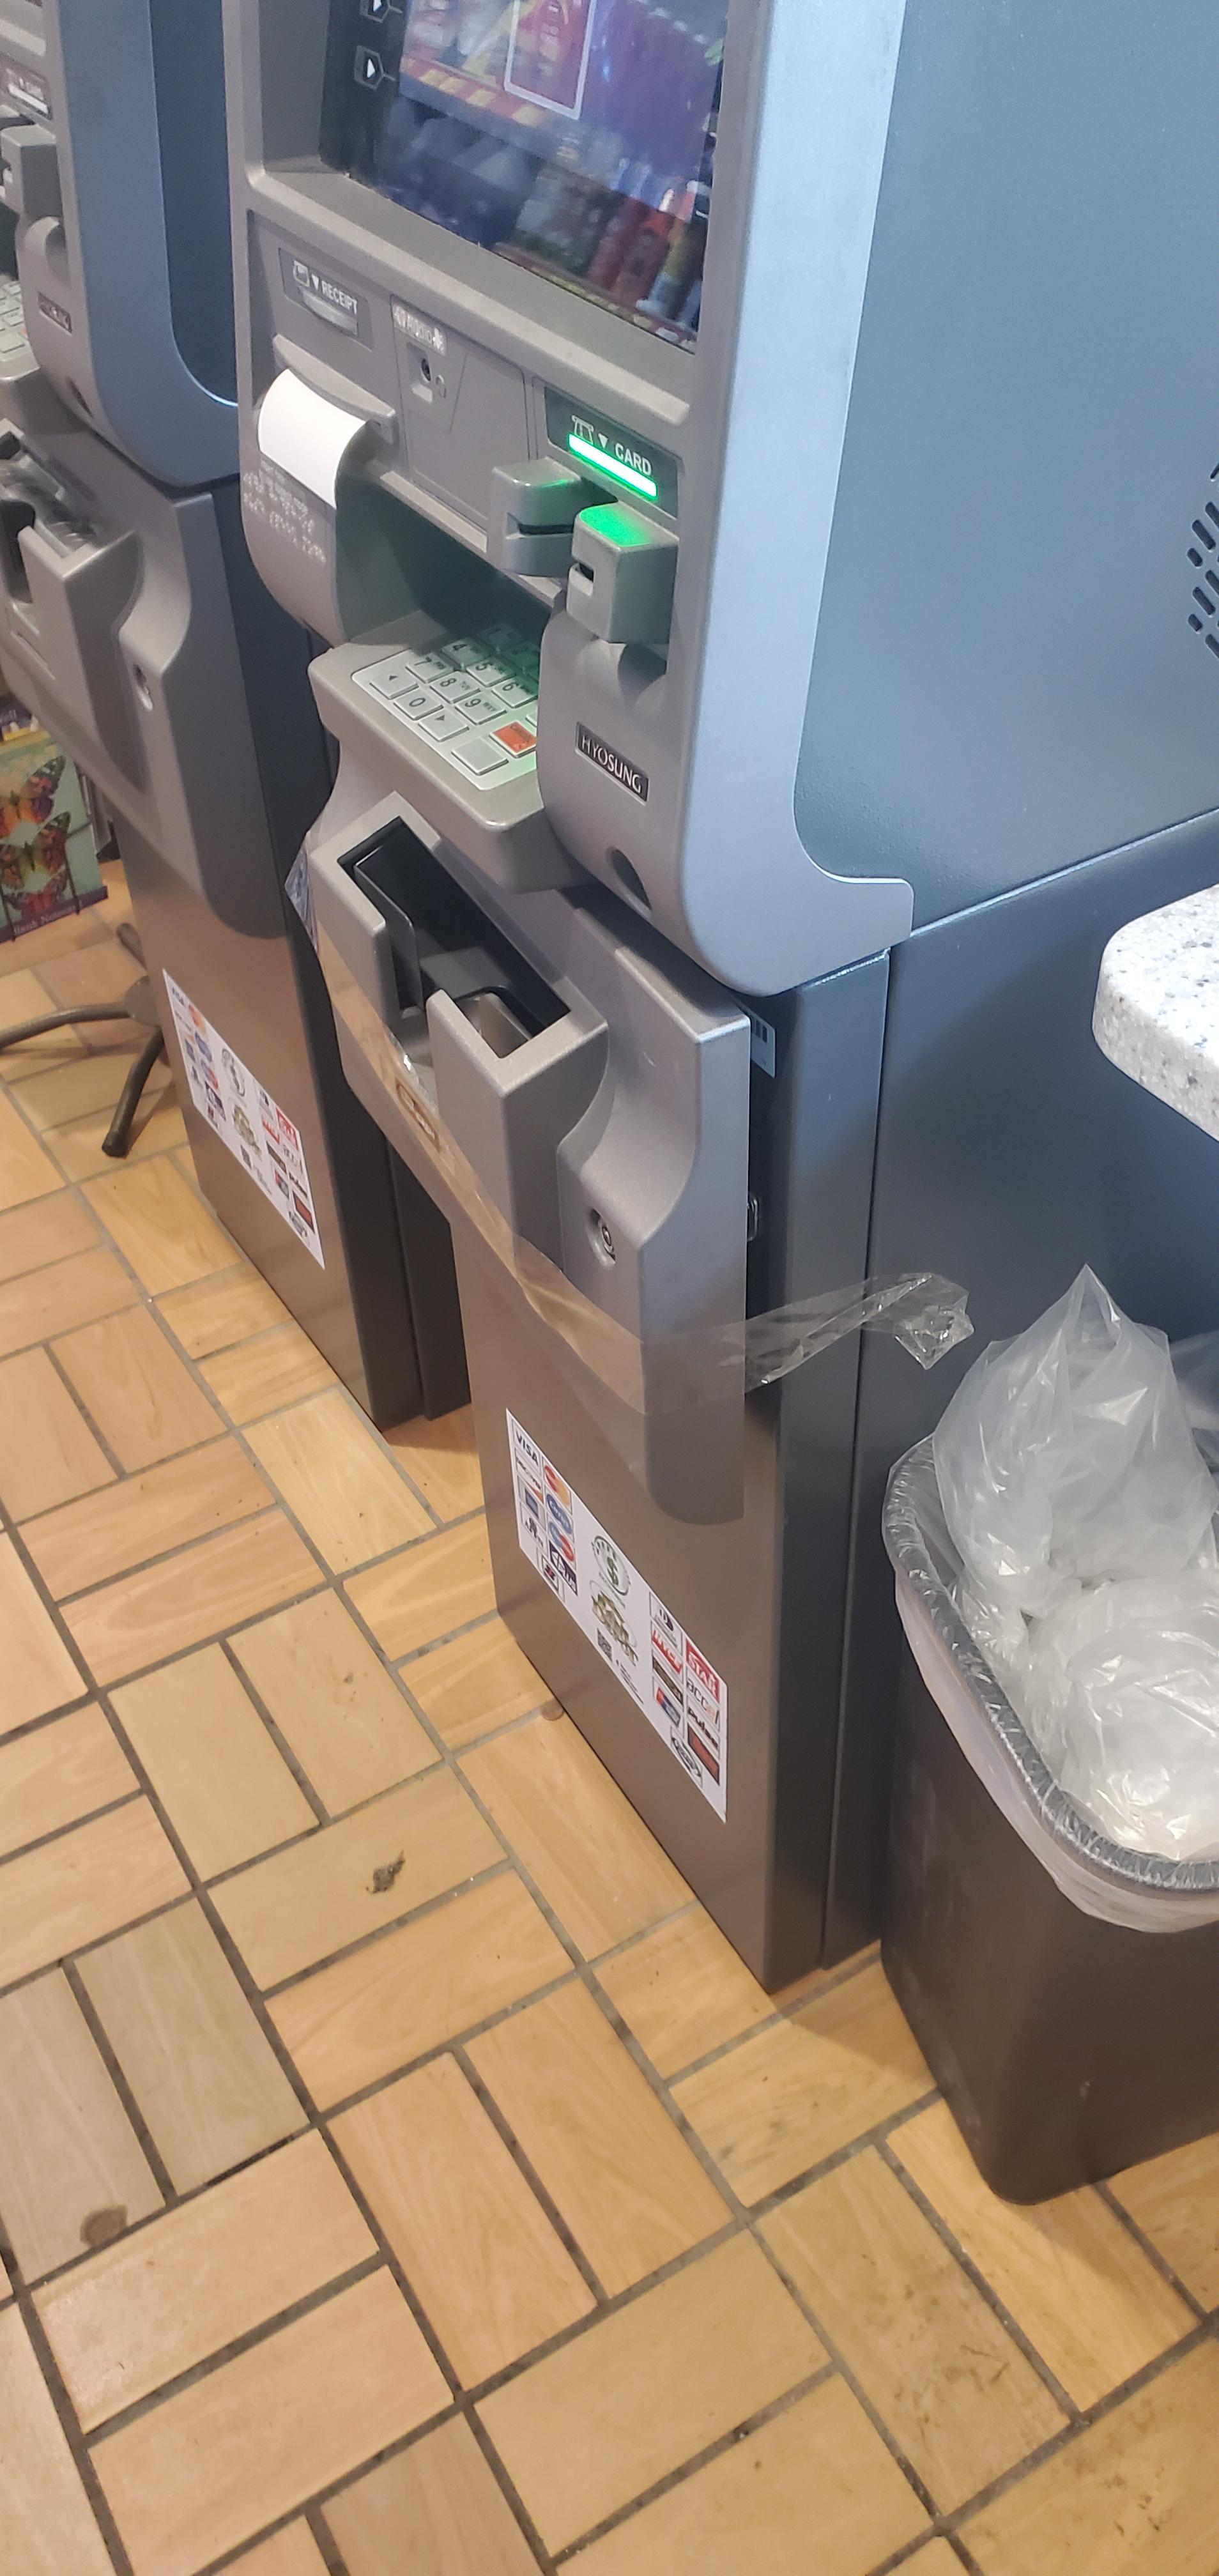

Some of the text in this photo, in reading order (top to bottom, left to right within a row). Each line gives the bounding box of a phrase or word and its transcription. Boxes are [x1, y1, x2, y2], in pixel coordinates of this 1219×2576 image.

[321, 280, 358, 314] RECEIPT
[615, 442, 652, 476] CARD
[415, 656, 433, 666] 7
[440, 677, 457, 687] 8
[502, 682, 519, 691] 6
[409, 697, 426, 708] 0
[464, 698, 482, 708] 9
[581, 735, 642, 793] HYOSUNG
[516, 1430, 539, 1466] VISA
[687, 1650, 717, 1698] STAR
